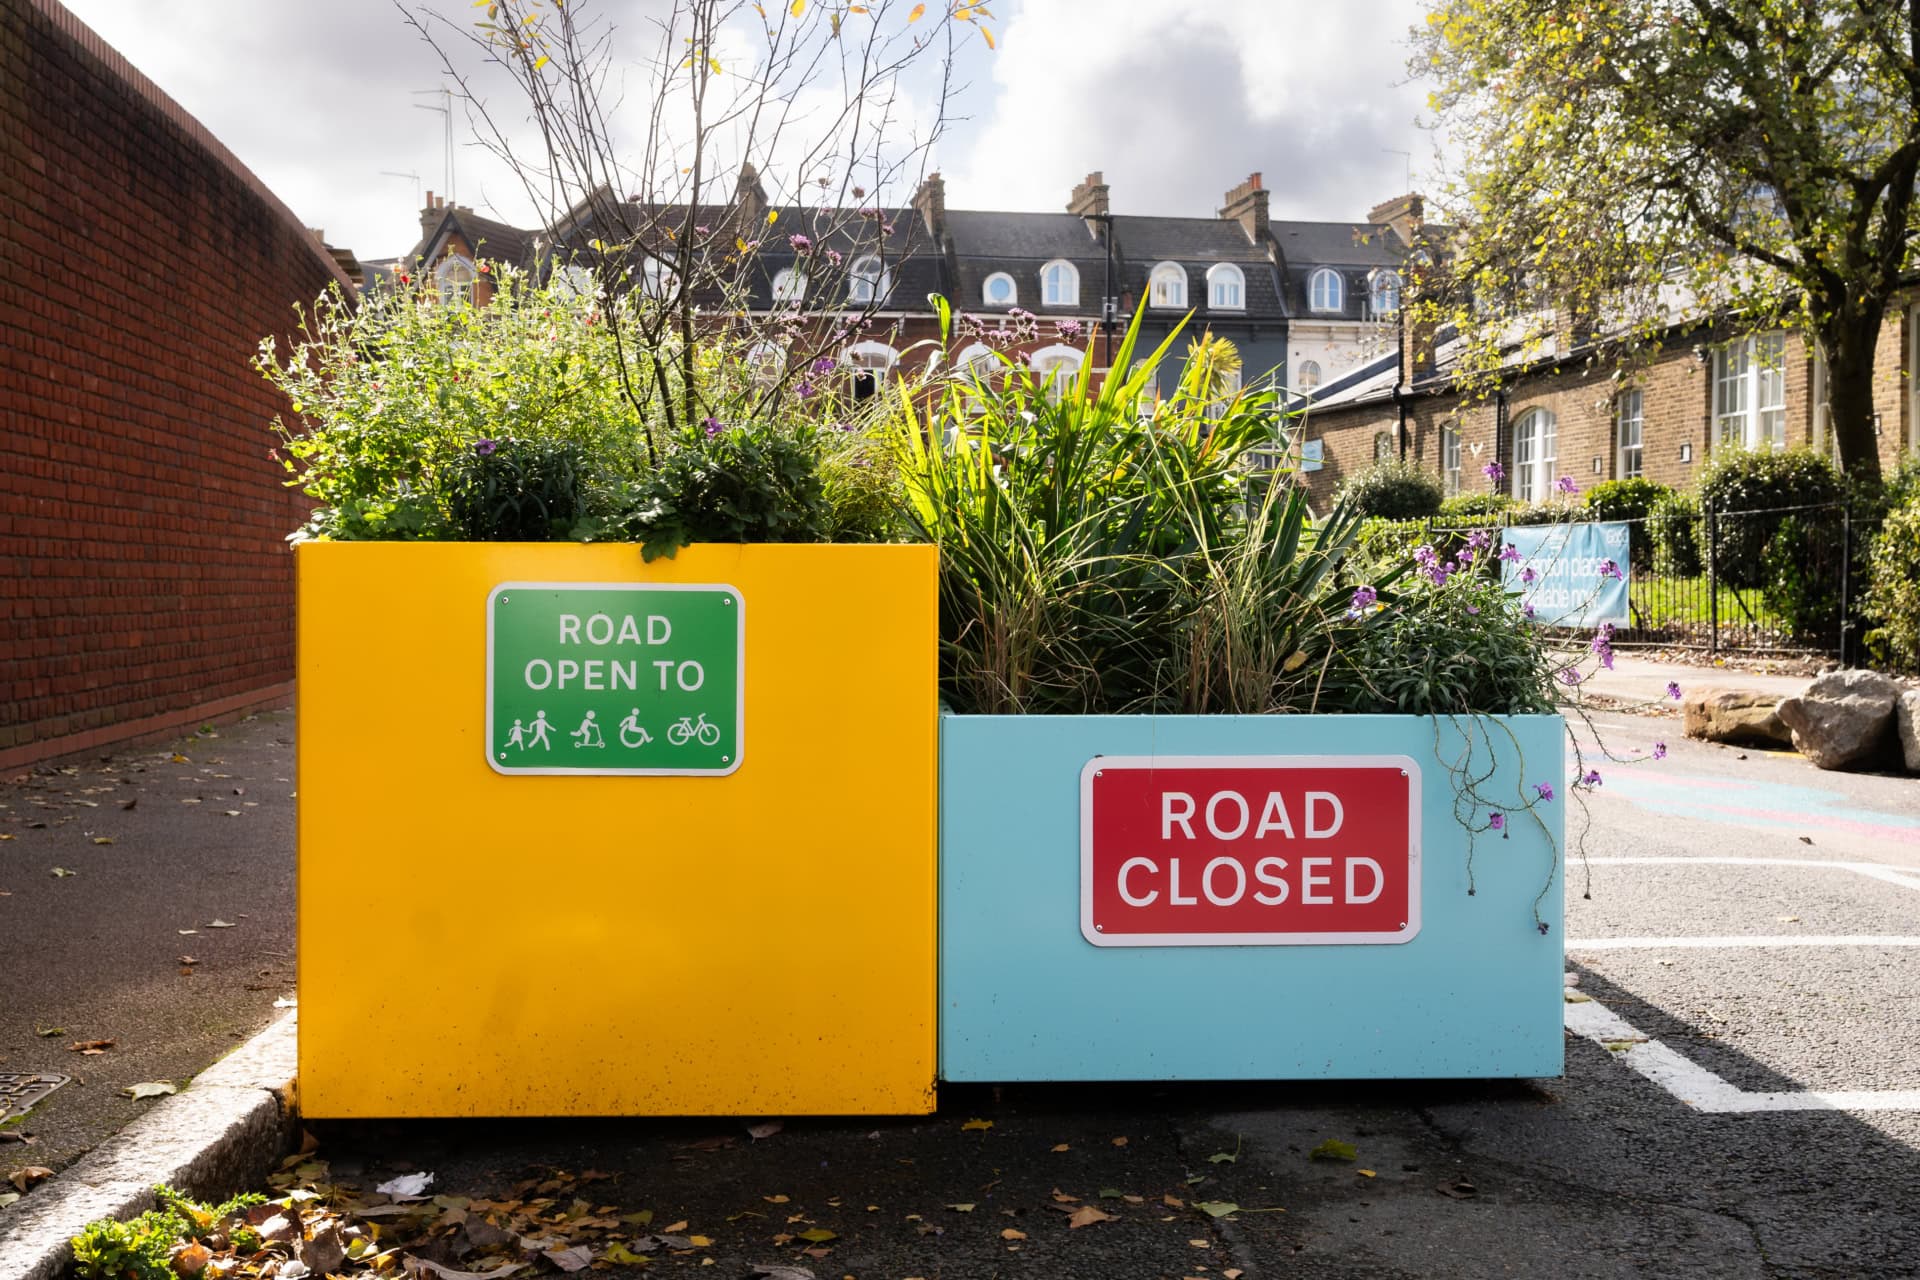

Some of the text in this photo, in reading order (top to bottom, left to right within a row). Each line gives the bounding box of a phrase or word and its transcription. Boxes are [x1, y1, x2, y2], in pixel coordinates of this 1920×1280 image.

[1571, 553, 1609, 581] place
[1521, 582, 1569, 609] ailable
[559, 613, 672, 645] ROAD
[524, 658, 705, 691] OPEN TO
[1161, 790, 1344, 840] ROAD
[1117, 856, 1385, 907] CLOSED
